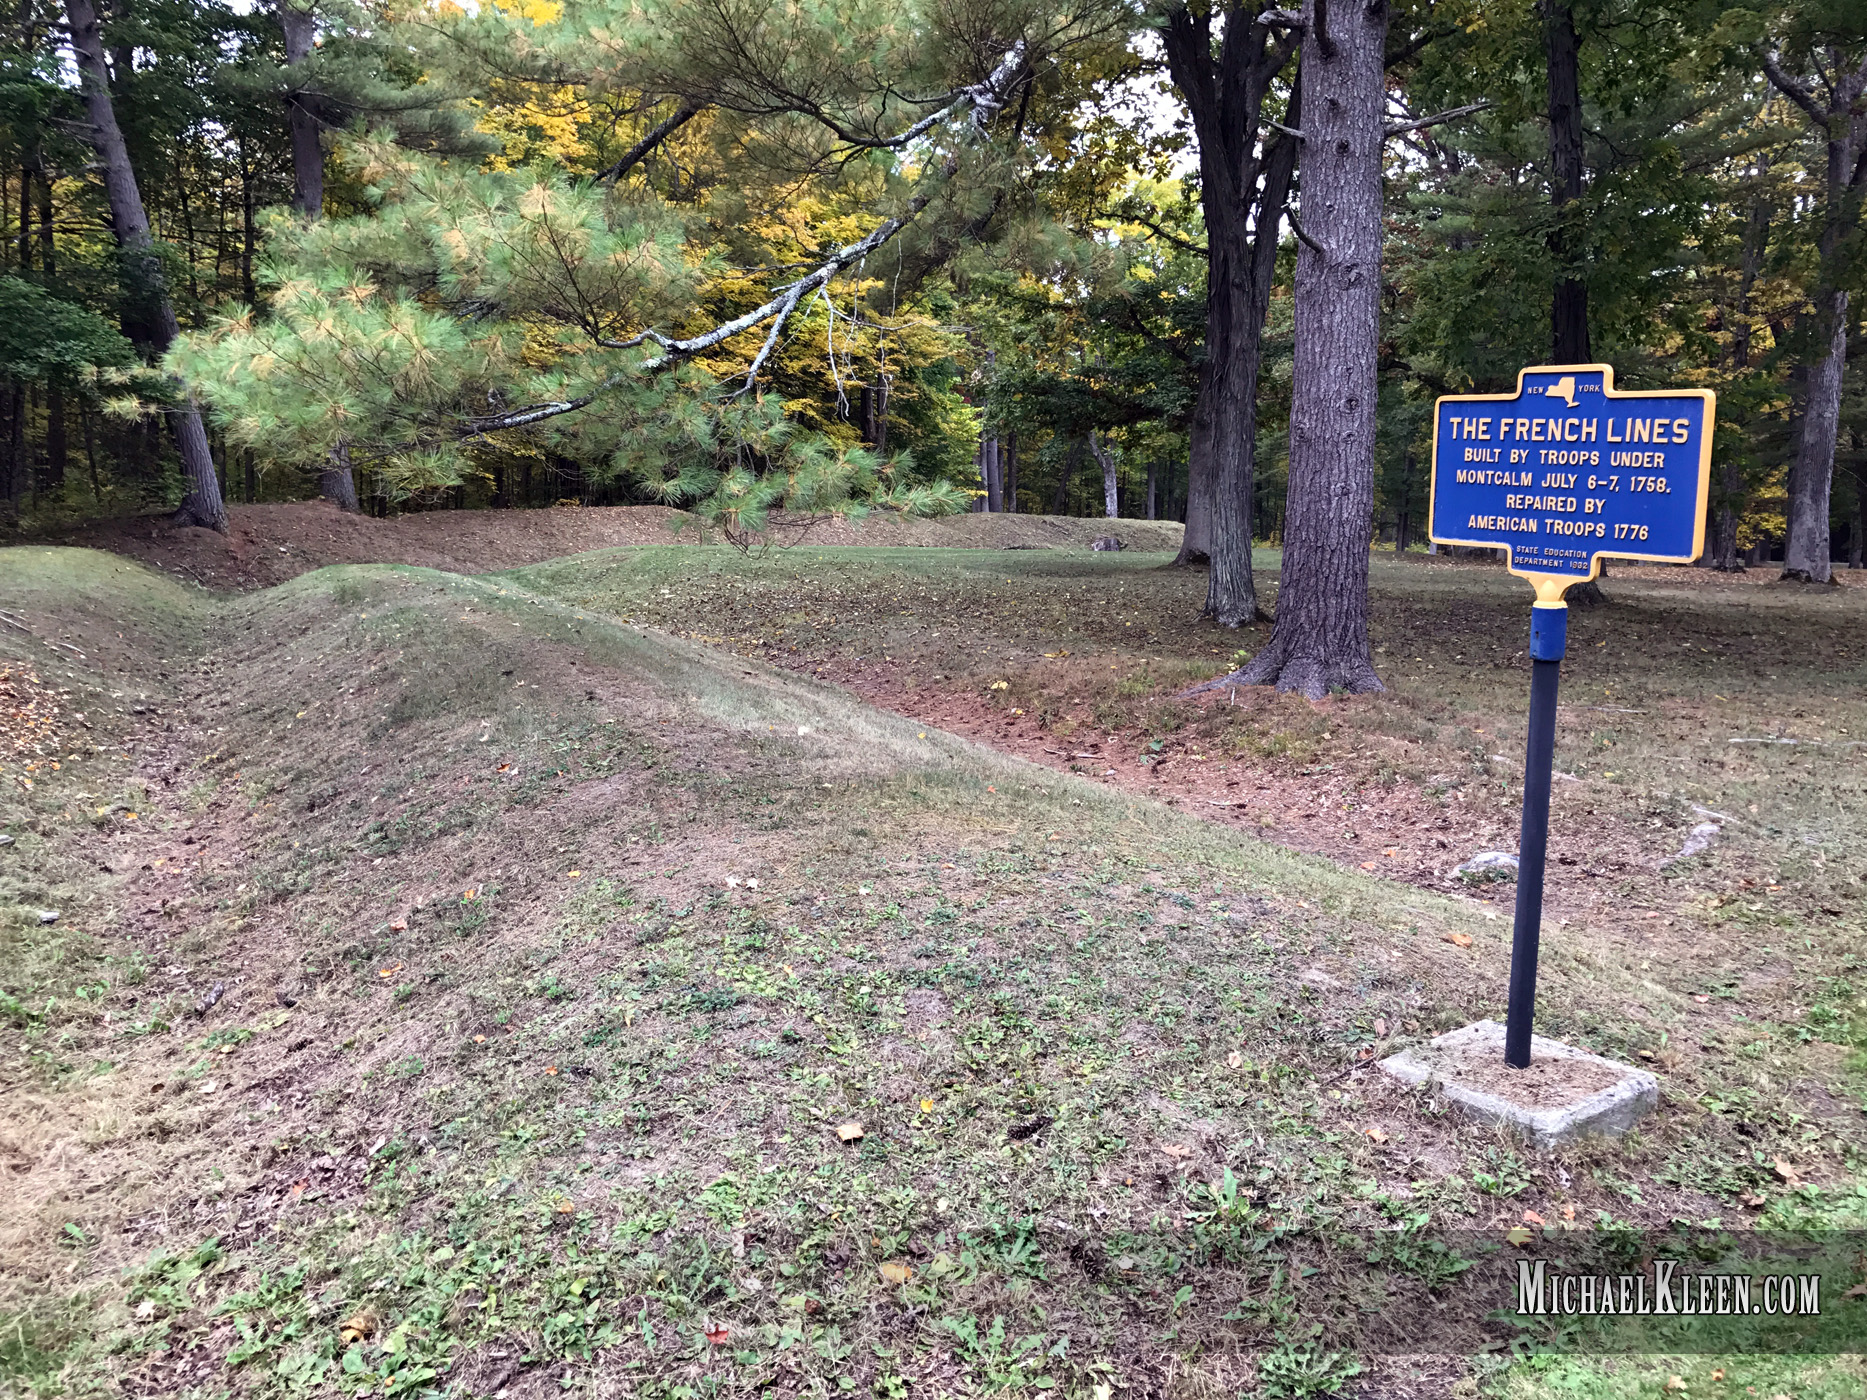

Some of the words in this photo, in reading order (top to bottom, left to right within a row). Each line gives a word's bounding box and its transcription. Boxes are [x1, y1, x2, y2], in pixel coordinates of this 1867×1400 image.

[1450, 417, 1491, 440] THE
[1500, 418, 1597, 442] FRENCH
[1607, 418, 1690, 443] LINES
[1464, 448, 1500, 462] BUILT
[1510, 450, 1529, 463] BY
[1540, 450, 1599, 466] TROOPS
[1611, 452, 1665, 468] UNDER
[1456, 470, 1532, 487] MONTCALM
[1542, 473, 1577, 489] JULY
[1588, 476, 1619, 492] 6-7,
[1631, 477, 1671, 493] 1758.
[1506, 495, 1577, 512] REPAIRED
[1585, 499, 1606, 514] BY
[1468, 515, 1537, 533] AMERICAN
[1545, 519, 1605, 537] TROOPS
[1614, 524, 1649, 540] 1776
[1516, 546, 1538, 554] STATE
[1545, 548, 1587, 558] EDUCATION
[1515, 557, 1563, 567] DEPARTMENT
[1570, 561, 1588, 569] 1932
